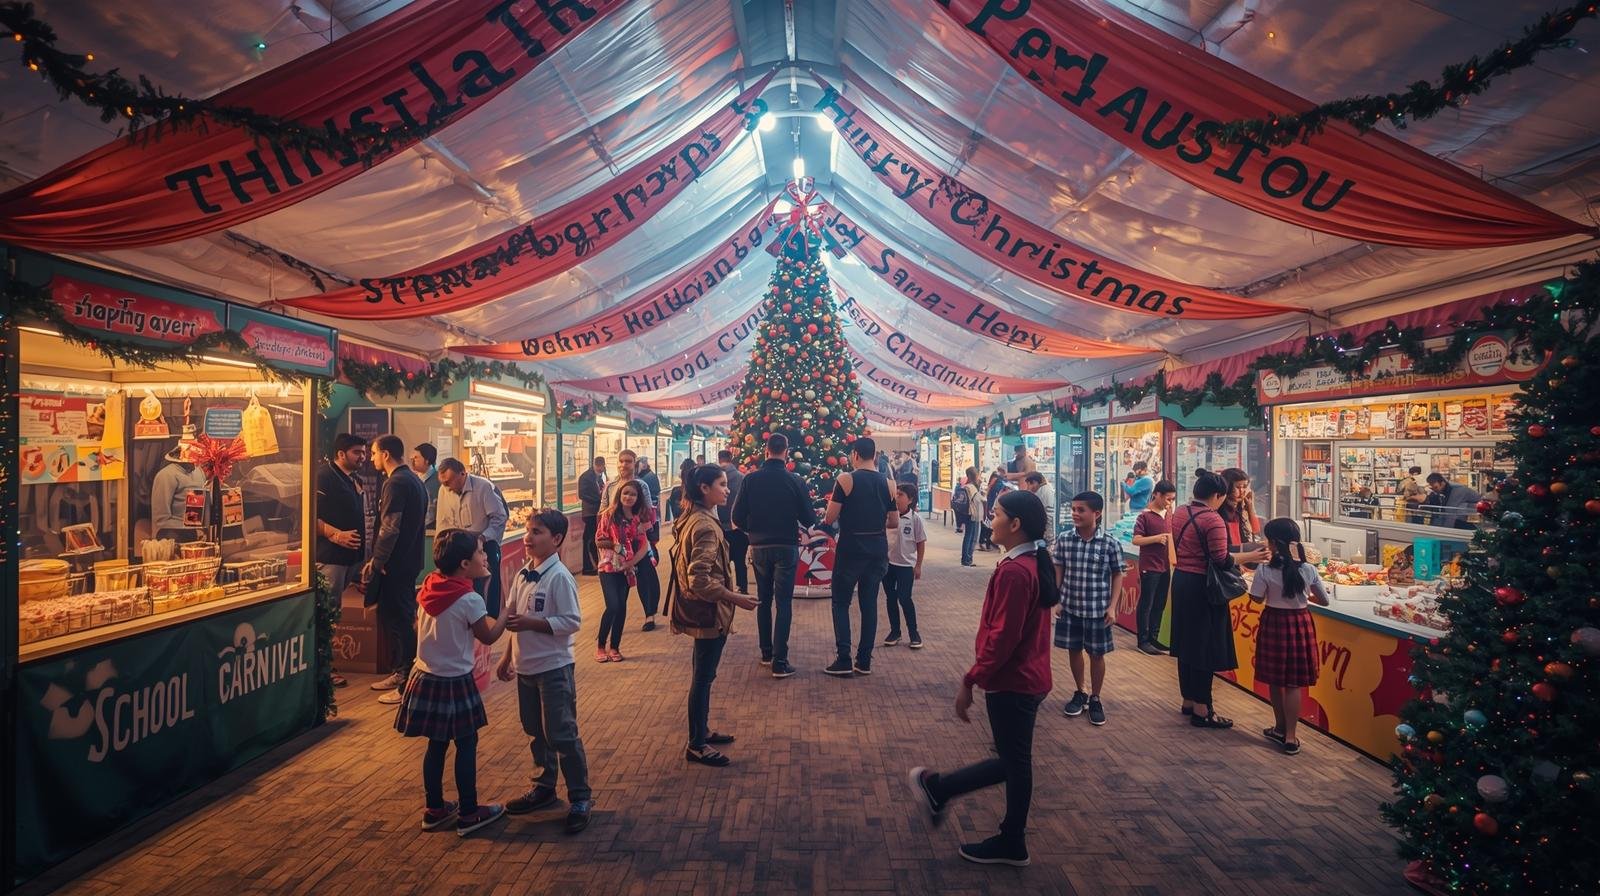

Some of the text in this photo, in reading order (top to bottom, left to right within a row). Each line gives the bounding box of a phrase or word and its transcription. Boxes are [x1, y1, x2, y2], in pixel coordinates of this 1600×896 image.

[950, 193, 1192, 315] Christmas
[88, 634, 308, 762] SCHOOL CARNIVEL
